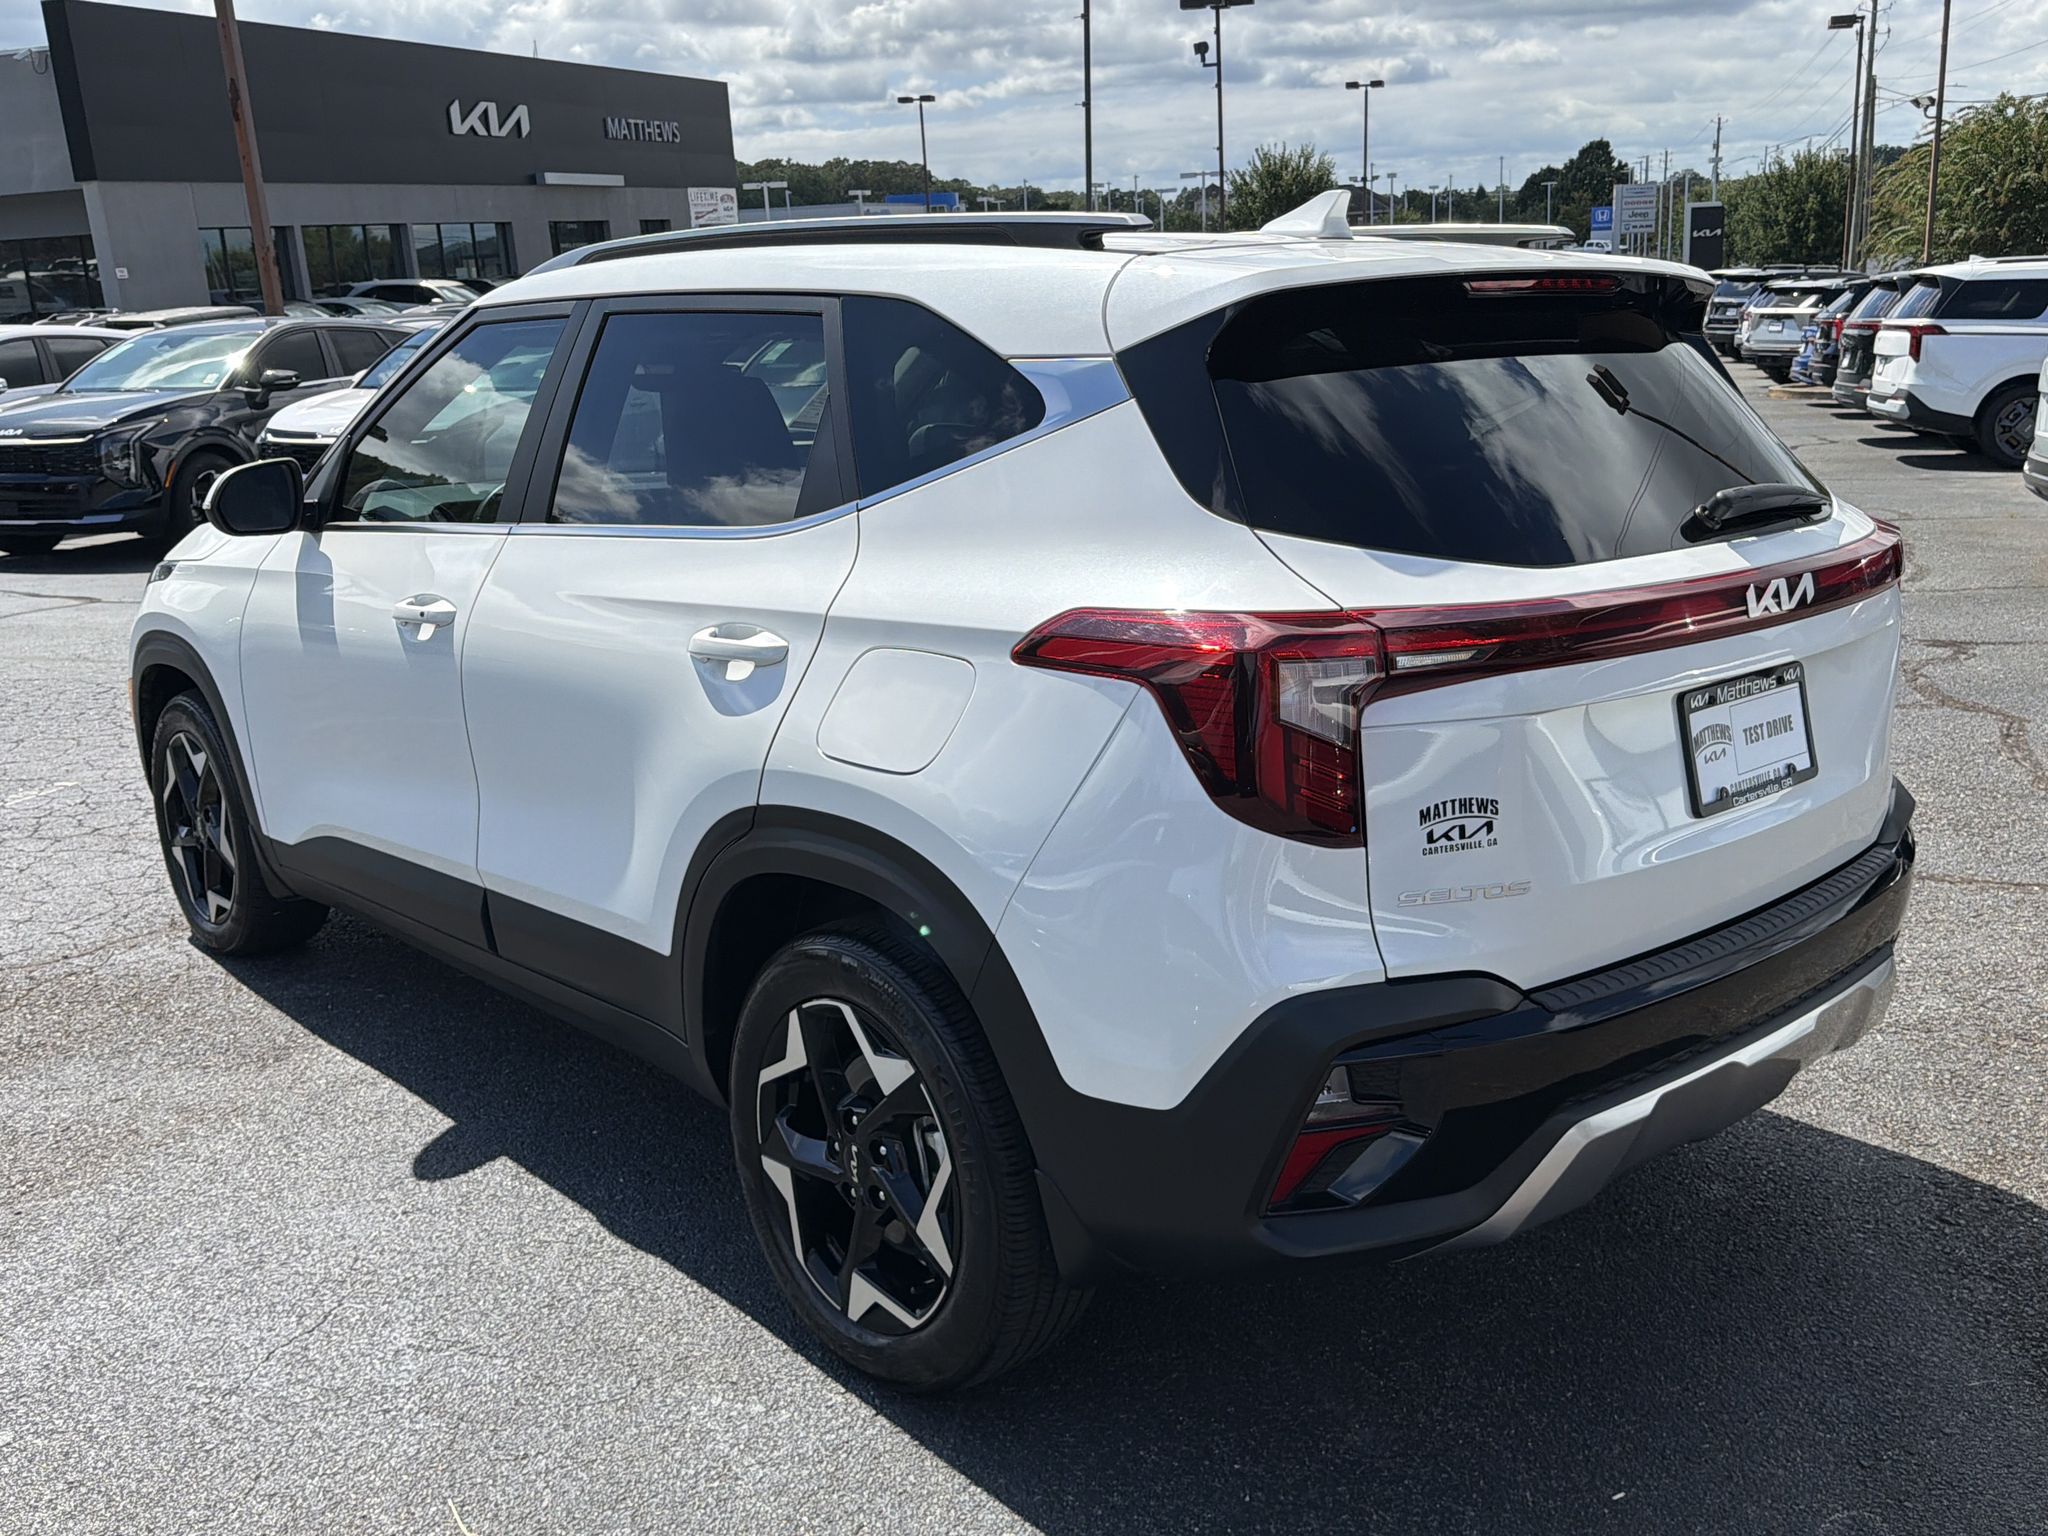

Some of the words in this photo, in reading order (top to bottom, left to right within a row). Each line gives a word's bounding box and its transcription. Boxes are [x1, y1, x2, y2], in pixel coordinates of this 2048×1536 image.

[607, 116, 681, 143] MATTHEWS
[1628, 211, 1649, 219] Jeep
[1745, 572, 1815, 618] KIA
[1716, 675, 1777, 704] Matthews
[1693, 723, 1732, 752] MATTHEWS
[1742, 722, 1765, 746] TEST
[1766, 714, 1794, 738] DRIVE
[1781, 777, 1793, 789] GA
[1419, 797, 1499, 826] MATTHEWS
[1422, 842, 1485, 856] CARTERSVILLE,
[1487, 838, 1498, 847] GA
[1397, 880, 1531, 908] SELTOS
